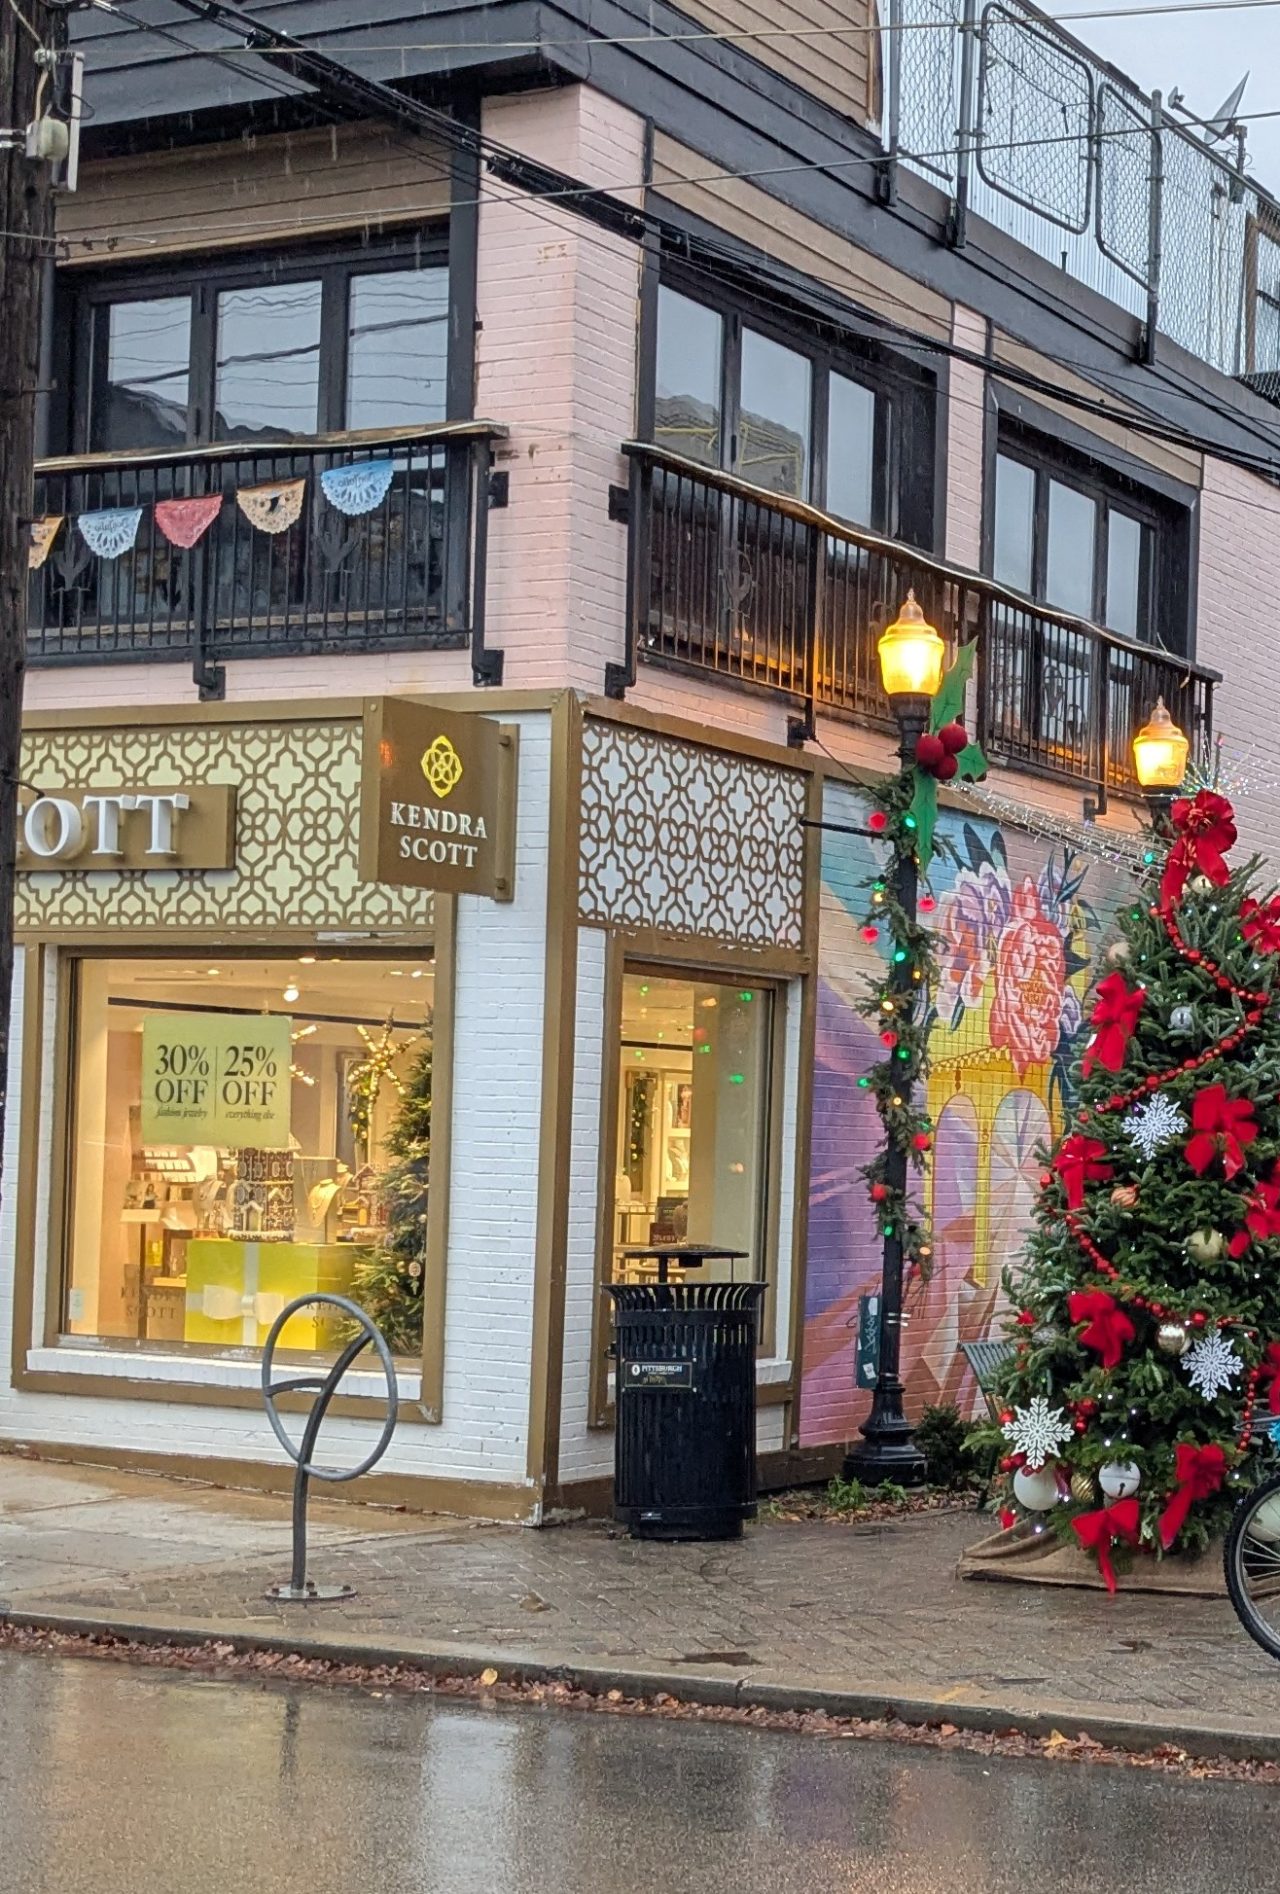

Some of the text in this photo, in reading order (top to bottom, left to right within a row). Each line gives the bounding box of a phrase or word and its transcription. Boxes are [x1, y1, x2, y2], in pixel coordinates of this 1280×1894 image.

[17, 793, 190, 860] OTT
[390, 801, 488, 839] KENDRA
[400, 835, 478, 868] SCOTT
[155, 1044, 210, 1076] 30%
[223, 1045, 277, 1077] 25%
[155, 1079, 209, 1104] OFF
[222, 1080, 278, 1106] OFF
